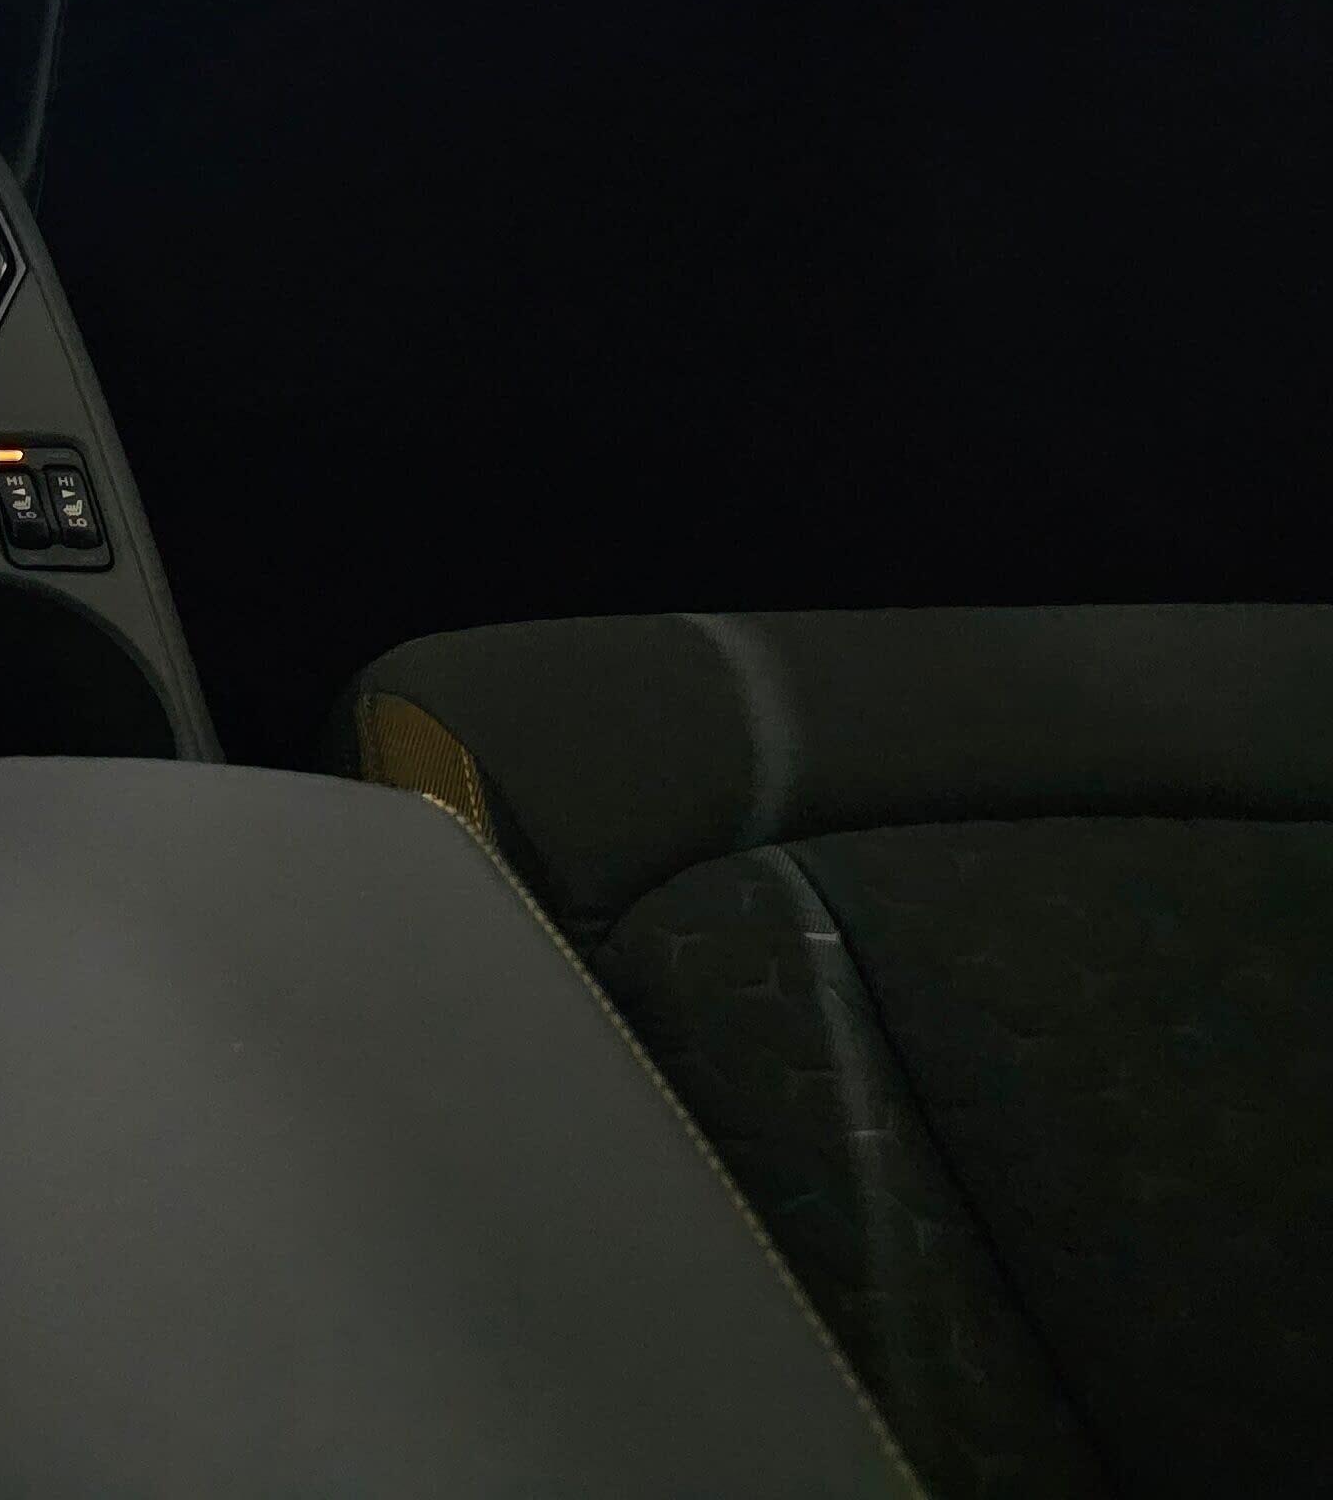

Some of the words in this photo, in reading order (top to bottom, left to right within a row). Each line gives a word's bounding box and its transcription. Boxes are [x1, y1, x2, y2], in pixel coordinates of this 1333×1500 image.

[6, 475, 24, 487] HI
[58, 476, 75, 487] HI
[17, 511, 37, 519] LO
[69, 518, 88, 528] LO
